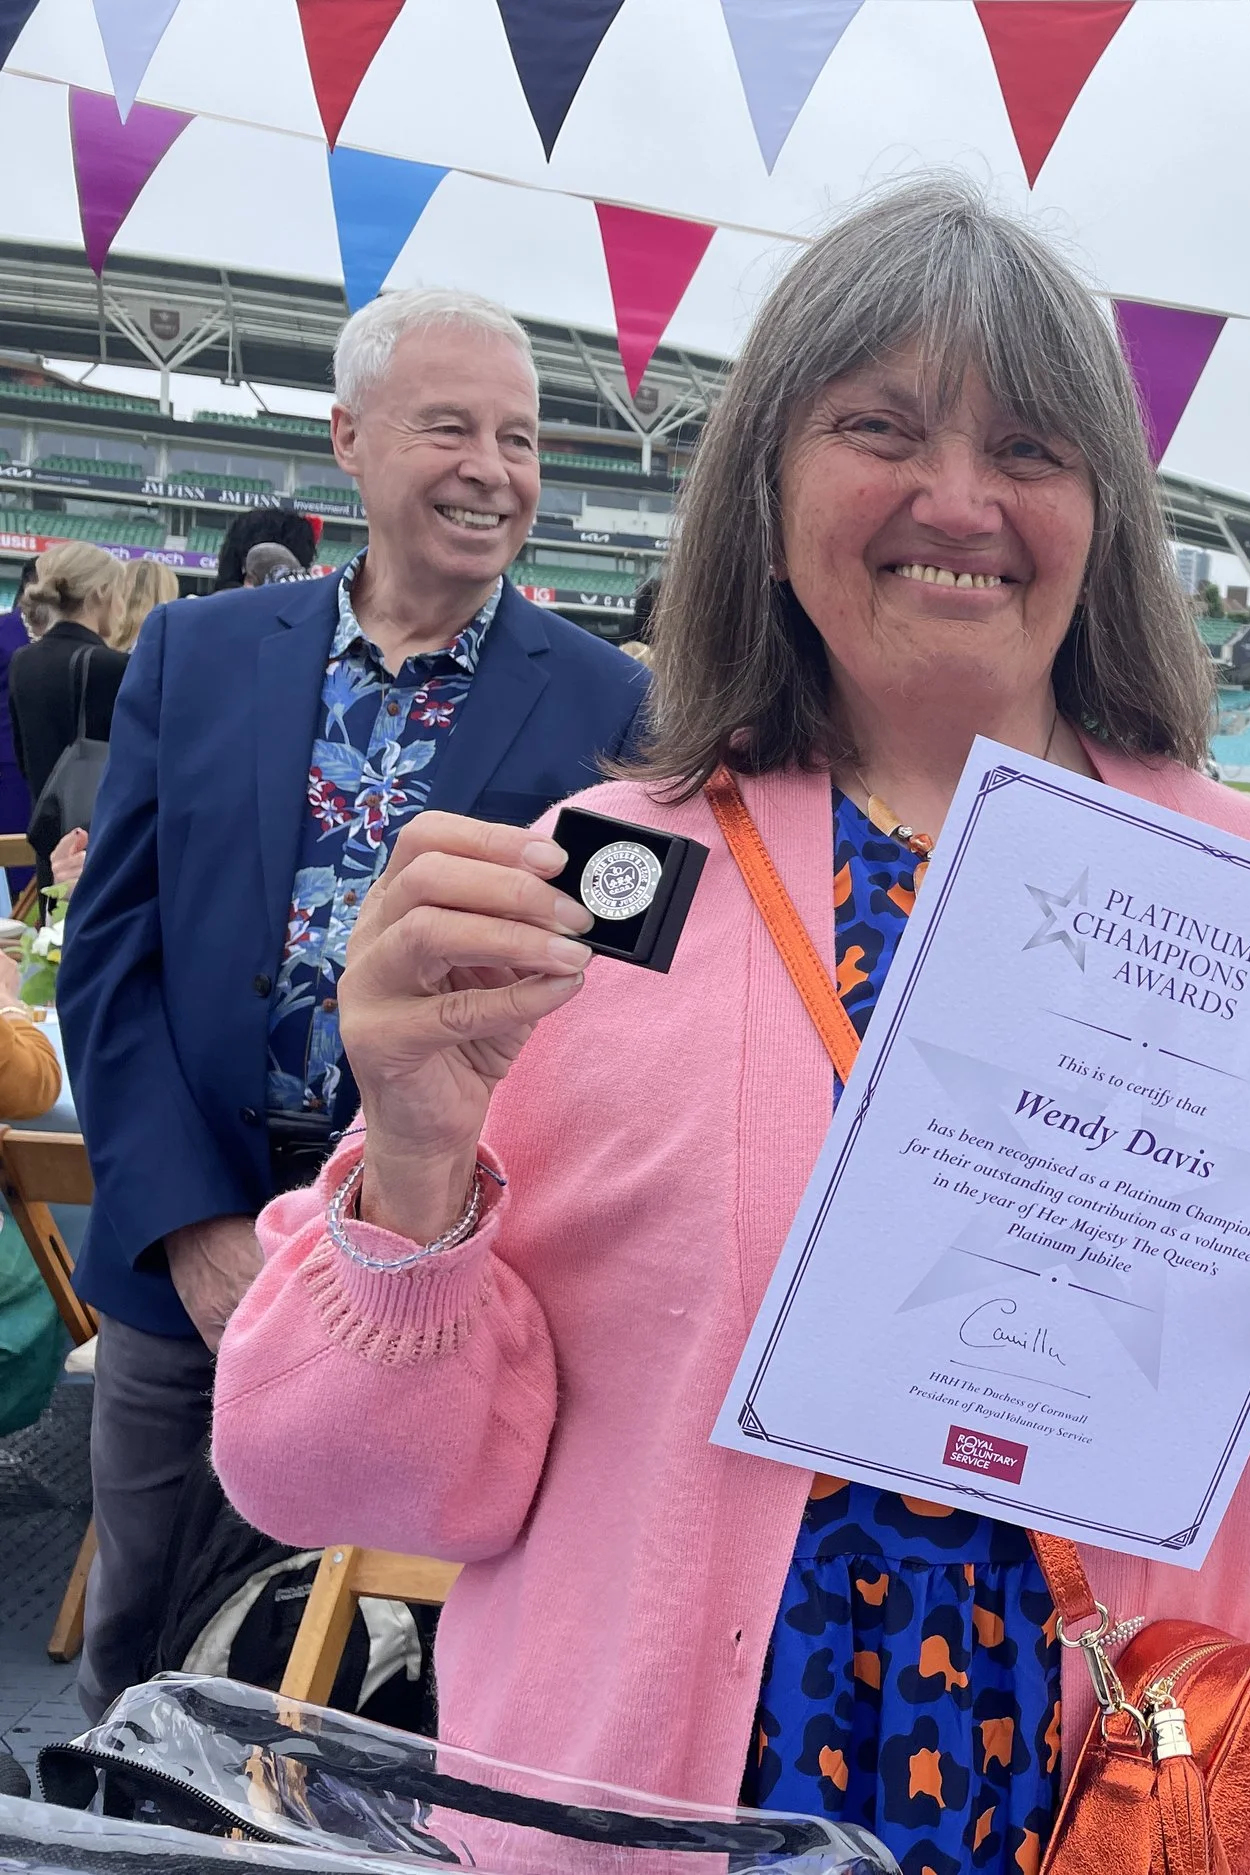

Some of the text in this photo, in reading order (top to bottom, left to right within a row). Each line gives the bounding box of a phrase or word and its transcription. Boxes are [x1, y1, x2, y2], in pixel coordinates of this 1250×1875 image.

[293, 499, 350, 515] Investment
[600, 893, 651, 917] CHAMPION
[1072, 911, 1248, 992] CHAMPIONS
[1112, 960, 1239, 1021] AWARDS
[1057, 1053, 1208, 1117] This is to certify that
[1014, 1089, 1215, 1178] Wendy Davis
[900, 1138, 931, 1155] for
[932, 1148, 972, 1169] their
[973, 1164, 1065, 1204] outstanding
[1067, 1194, 1157, 1231] contribution
[1160, 1226, 1178, 1237] as
[1180, 1233, 1191, 1242] a
[927, 1118, 956, 1138] has
[958, 1128, 994, 1151] been
[997, 1145, 1079, 1178] recognised
[1078, 1173, 1097, 1185] as
[1099, 1180, 1110, 1189] a
[1113, 1181, 1182, 1213] Platinum
[932, 1172, 1220, 1278] in the year of Her Majesty The Queen's
[1006, 1223, 1132, 1273] Platinum Jubilee
[908, 1385, 1093, 1445] President of Royal Voluntary Service
[929, 1371, 1090, 1425] HRH The Duchess of Cornwall
[950, 1452, 991, 1470] SERVICE
[955, 1442, 1018, 1467] VOLUNTARY
[957, 1434, 994, 1452] ROYAL
